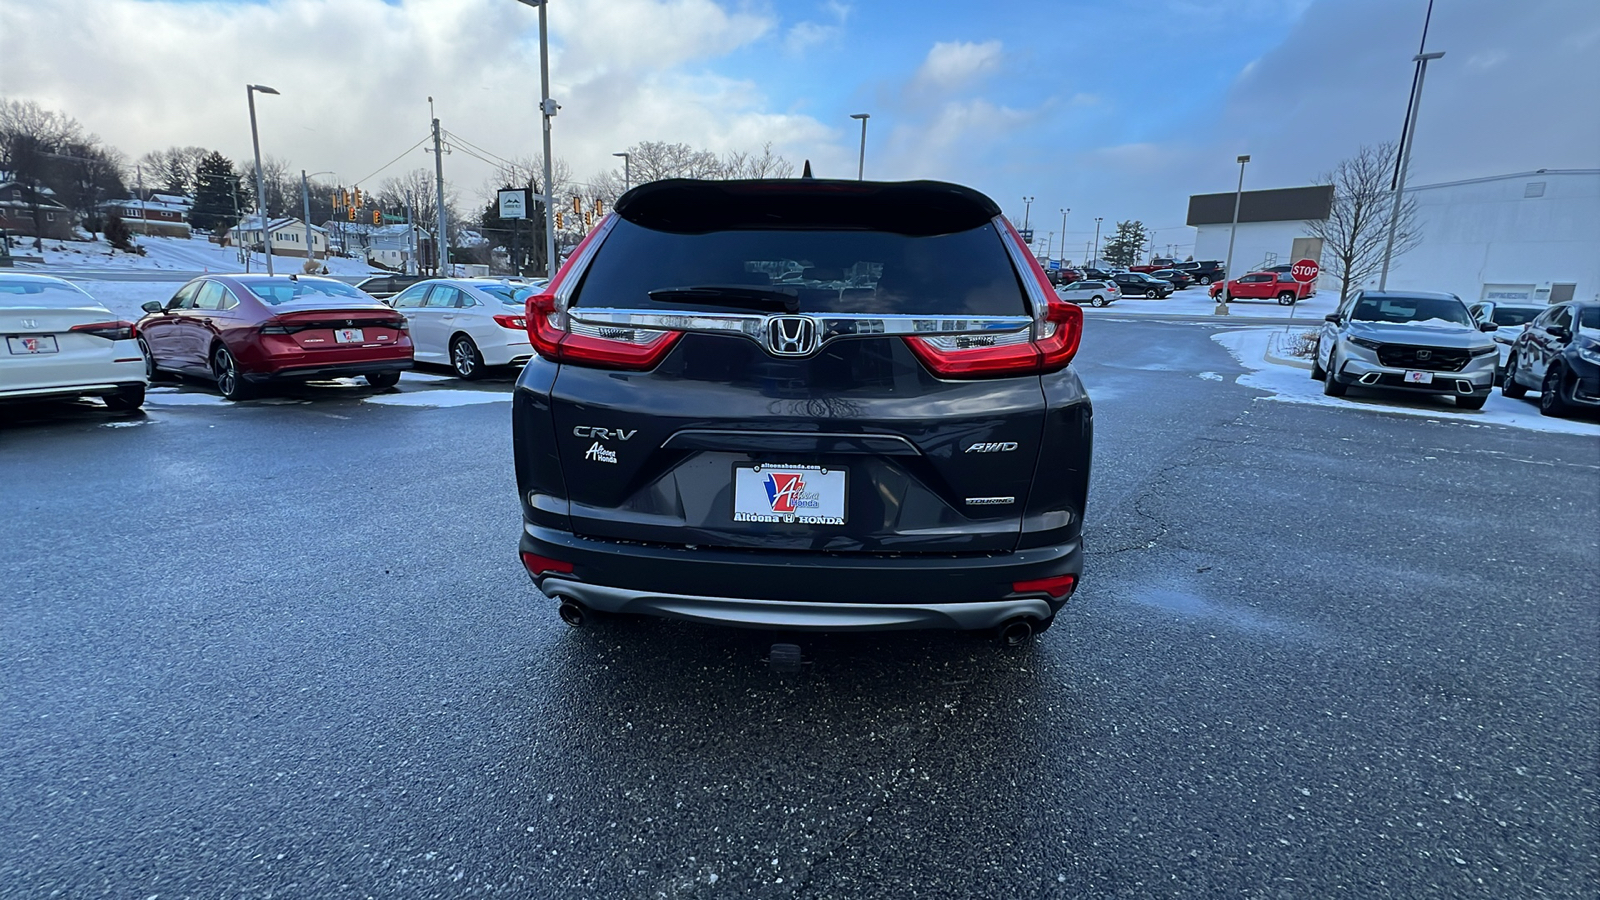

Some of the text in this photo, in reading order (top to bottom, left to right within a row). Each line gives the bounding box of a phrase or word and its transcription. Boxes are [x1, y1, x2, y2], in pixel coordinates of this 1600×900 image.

[1292, 265, 1318, 276] STOP
[573, 425, 638, 441] CR-V
[965, 441, 1018, 453] AWD
[598, 454, 618, 464] Honda
[761, 462, 821, 470] altoonahonda.com
[791, 498, 819, 508] Honda
[734, 512, 845, 525] Altoona HONDA
